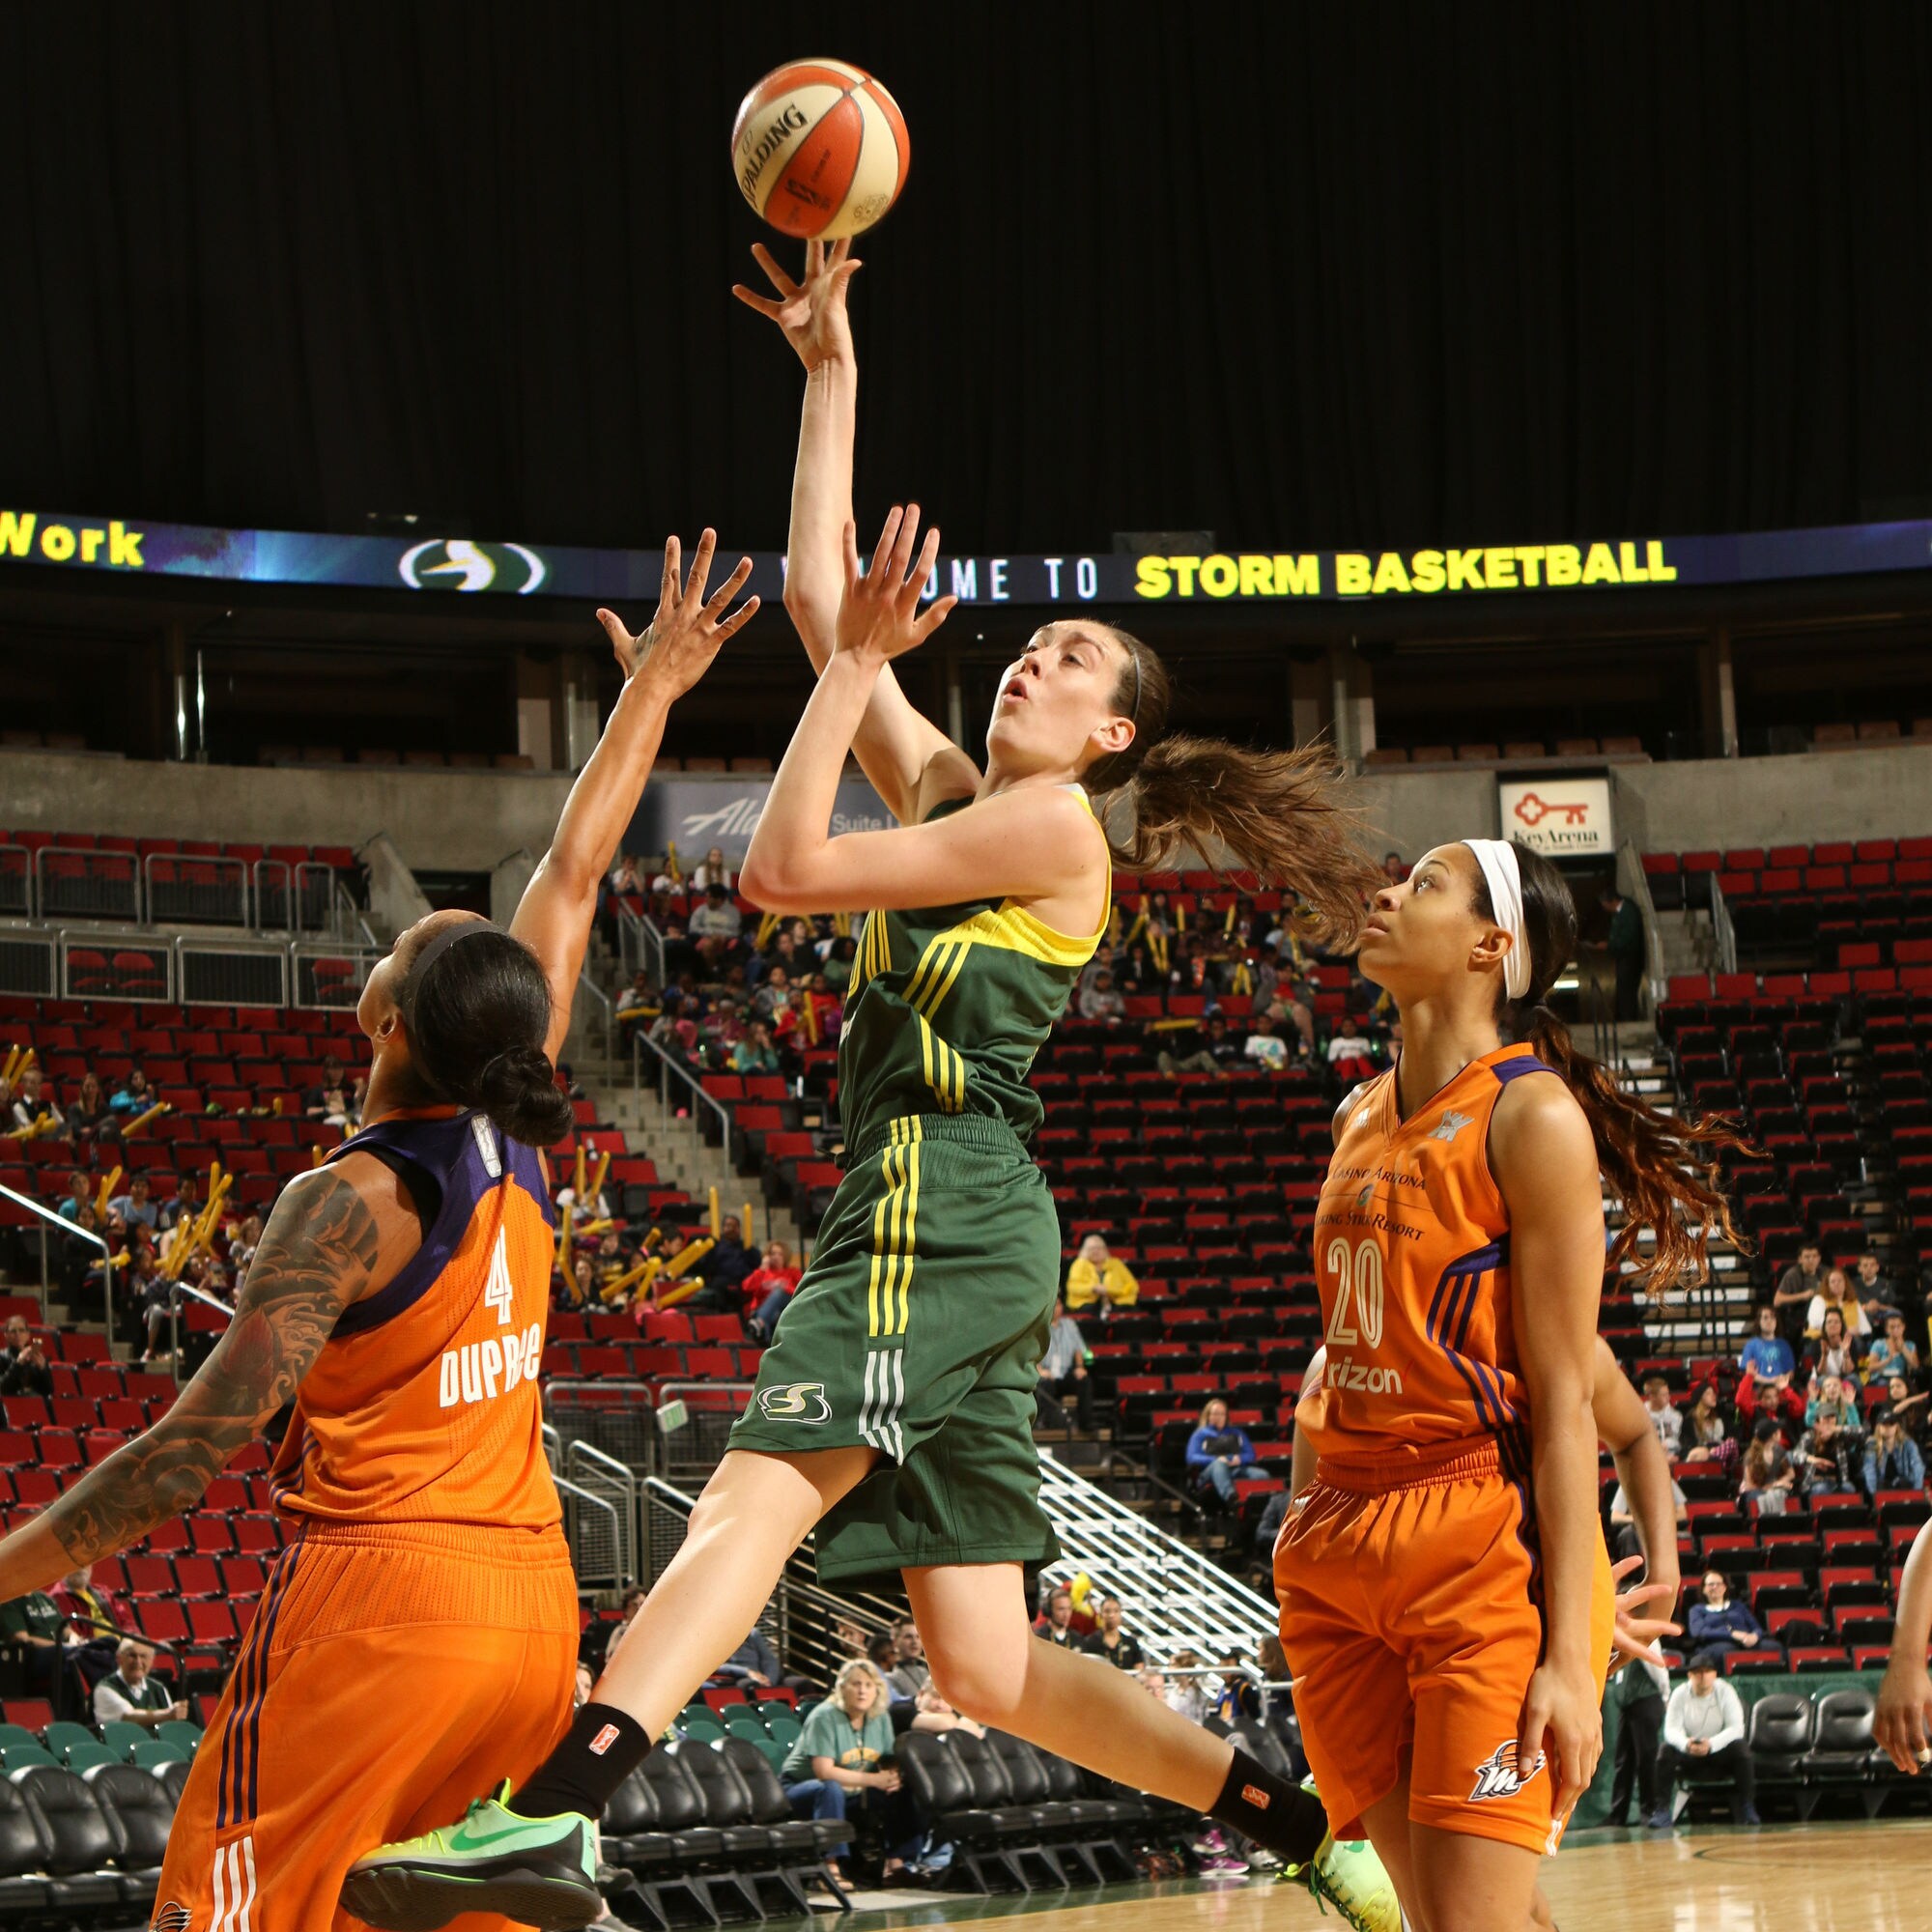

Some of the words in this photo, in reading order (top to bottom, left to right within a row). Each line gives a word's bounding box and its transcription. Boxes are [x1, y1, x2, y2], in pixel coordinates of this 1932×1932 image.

[0, 510, 144, 567] Work
[1043, 557, 1097, 599] TO
[1134, 554, 1319, 598] STORM
[1335, 540, 1677, 594] BASKETBALL
[833, 812, 883, 833] Suite
[485, 1223, 513, 1325] 4
[1326, 1236, 1384, 1350] 20
[1327, 1356, 1403, 1394] rizon
